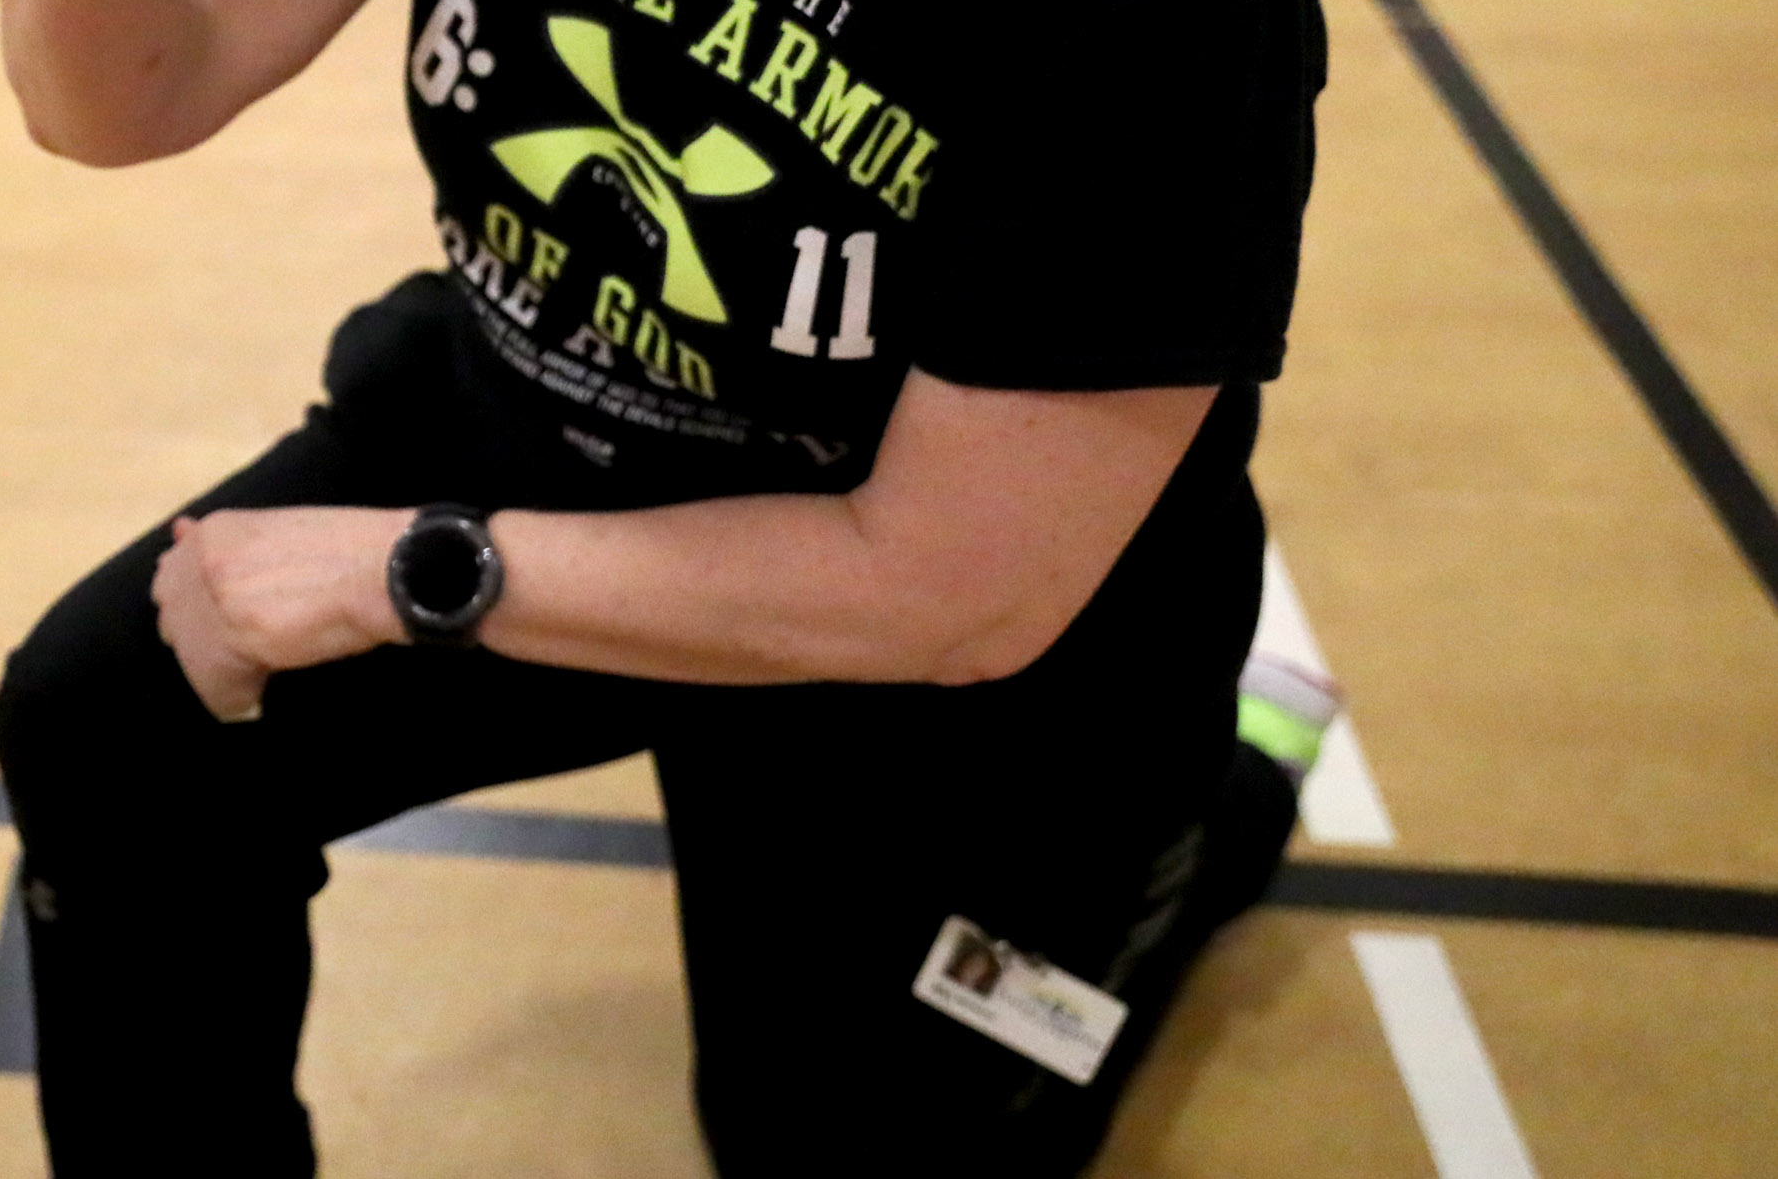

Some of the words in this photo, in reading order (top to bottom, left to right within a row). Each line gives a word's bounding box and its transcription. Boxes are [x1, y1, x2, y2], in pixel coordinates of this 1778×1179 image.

[484, 203, 570, 284] OF
[770, 225, 878, 360] 11
[592, 275, 716, 401] GOD
